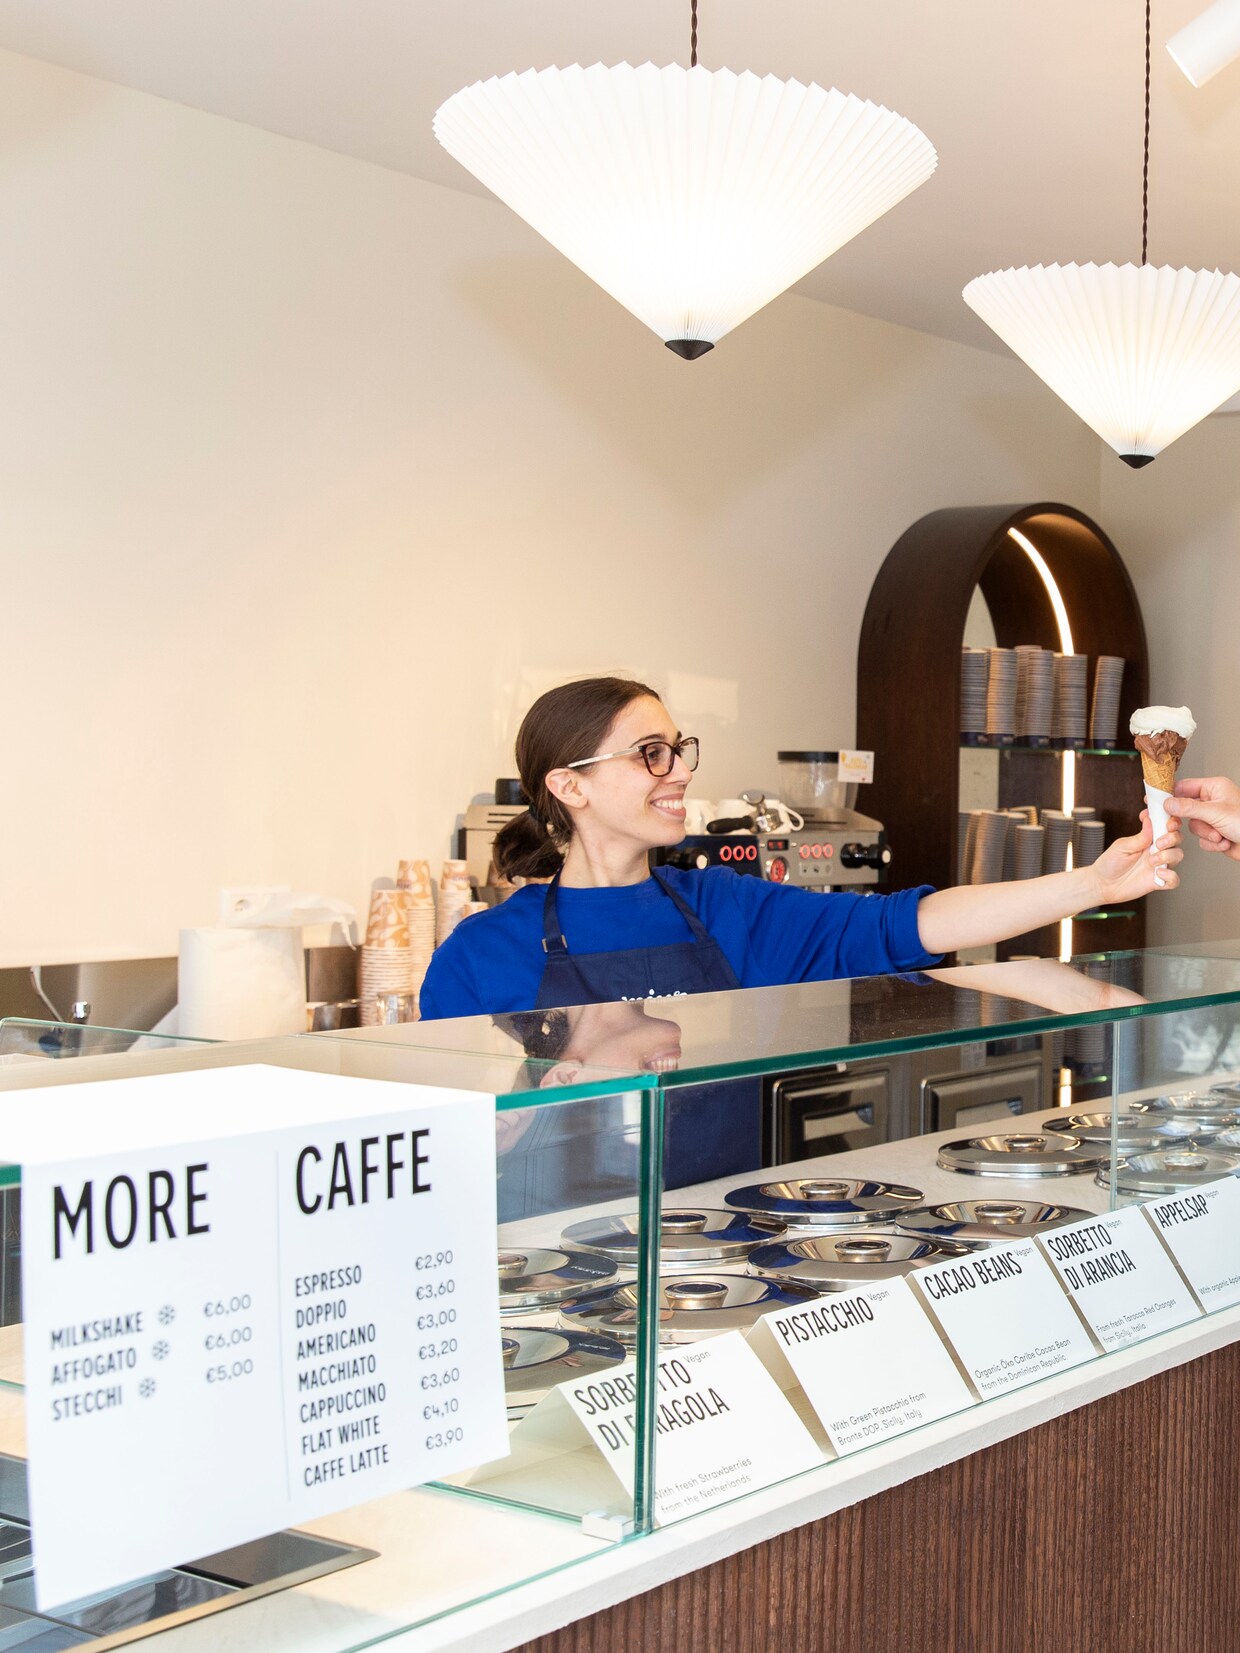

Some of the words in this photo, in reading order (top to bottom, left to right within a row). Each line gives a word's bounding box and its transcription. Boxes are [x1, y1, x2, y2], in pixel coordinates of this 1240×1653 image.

[296, 1128, 432, 1215] CAFFE
[52, 1162, 210, 1260] MORE
[1154, 1194, 1209, 1228] APPELSAP
[1047, 1224, 1112, 1261] SORBETTO
[295, 1265, 362, 1297] ESPRESSO
[415, 1250, 454, 1271] €2,90
[924, 1265, 977, 1300] CACAO
[972, 1251, 1023, 1285] BEANS
[1013, 1247, 1034, 1257] Vegan
[1063, 1266, 1085, 1290] DI
[1080, 1249, 1137, 1286] ARANCIA
[51, 1311, 144, 1351] MILKSHAKE
[204, 1294, 252, 1318] €6,00
[296, 1299, 347, 1329] DOPPIO
[416, 1279, 456, 1300] €3,60
[775, 1296, 874, 1346] PISTACCHIO
[866, 1289, 891, 1301] Vegan
[51, 1347, 137, 1386] AFFOGATO
[205, 1326, 253, 1351] €6,00
[297, 1323, 376, 1361] AMERICANO
[417, 1308, 457, 1330] €3,00
[683, 1350, 711, 1364] Vegan
[974, 1364, 1002, 1379] Organic
[1013, 1352, 1036, 1365] Caribe
[1034, 1346, 1056, 1357] Cacao
[1054, 1338, 1072, 1349] Bean
[53, 1385, 123, 1422] STECCHI
[206, 1358, 254, 1384] €5,00
[298, 1354, 376, 1392] MACCHIATO
[418, 1338, 458, 1360] €3,20
[981, 1381, 998, 1391] from
[997, 1375, 1009, 1386] the
[1007, 1364, 1041, 1381] Dominican
[1039, 1354, 1067, 1369] Republic
[300, 1383, 387, 1423] CAPPUCCINO
[421, 1367, 460, 1390] €3,60
[830, 1419, 850, 1432] With
[849, 1411, 874, 1426] Green
[872, 1398, 910, 1417] Pistacchio
[908, 1392, 927, 1403] from
[302, 1428, 333, 1456] FLAT
[338, 1415, 381, 1445] WHITE
[423, 1398, 459, 1420] €4,10
[597, 1420, 630, 1451] DI
[837, 1431, 864, 1446] Bronte
[881, 1416, 906, 1430] Sicily,
[903, 1409, 923, 1421] Italy
[304, 1457, 346, 1487] CAFFE
[350, 1444, 390, 1473] LATTE
[425, 1427, 464, 1450] €3,90
[675, 1478, 699, 1492] fresh
[697, 1458, 752, 1483] Strawberries
[660, 1501, 684, 1514] from
[684, 1493, 700, 1506] the
[699, 1474, 752, 1500] Netherlands
